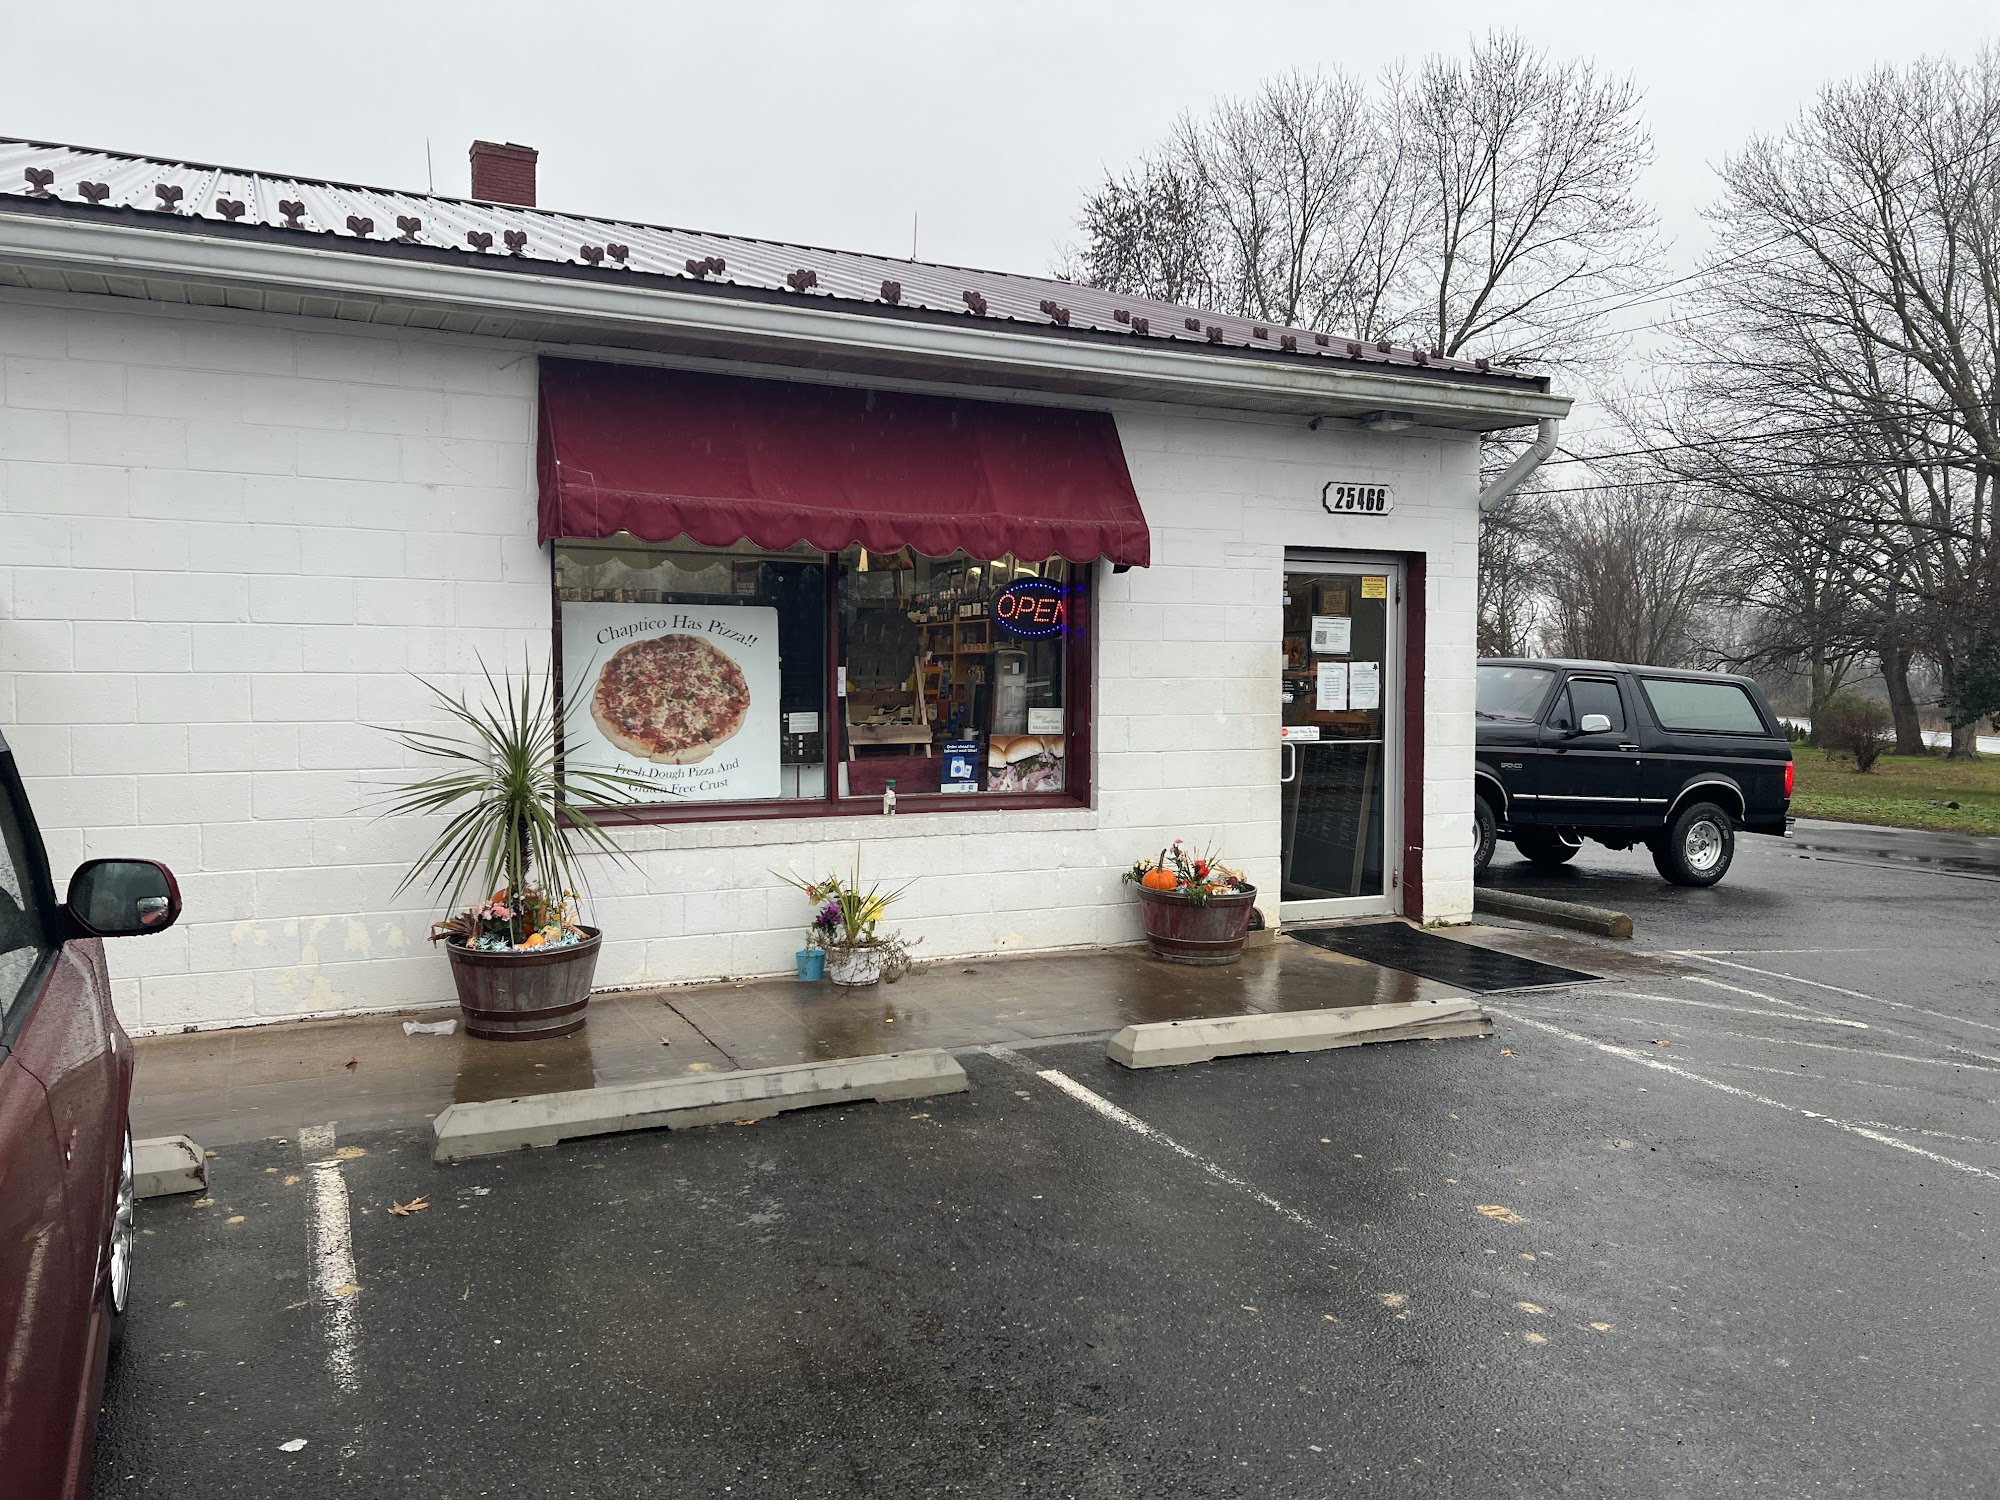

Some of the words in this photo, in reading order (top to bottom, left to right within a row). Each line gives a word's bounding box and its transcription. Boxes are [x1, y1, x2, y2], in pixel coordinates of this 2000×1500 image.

[1335, 487, 1385, 511] 25466
[596, 616, 667, 645] Chaptico
[671, 614, 703, 630] Has
[707, 619, 758, 647] Pizza!!
[648, 767, 685, 781] Dough
[688, 767, 715, 777] Pizza
[717, 758, 740, 773] And
[671, 783, 697, 794] Free
[699, 778, 728, 791] Crust
